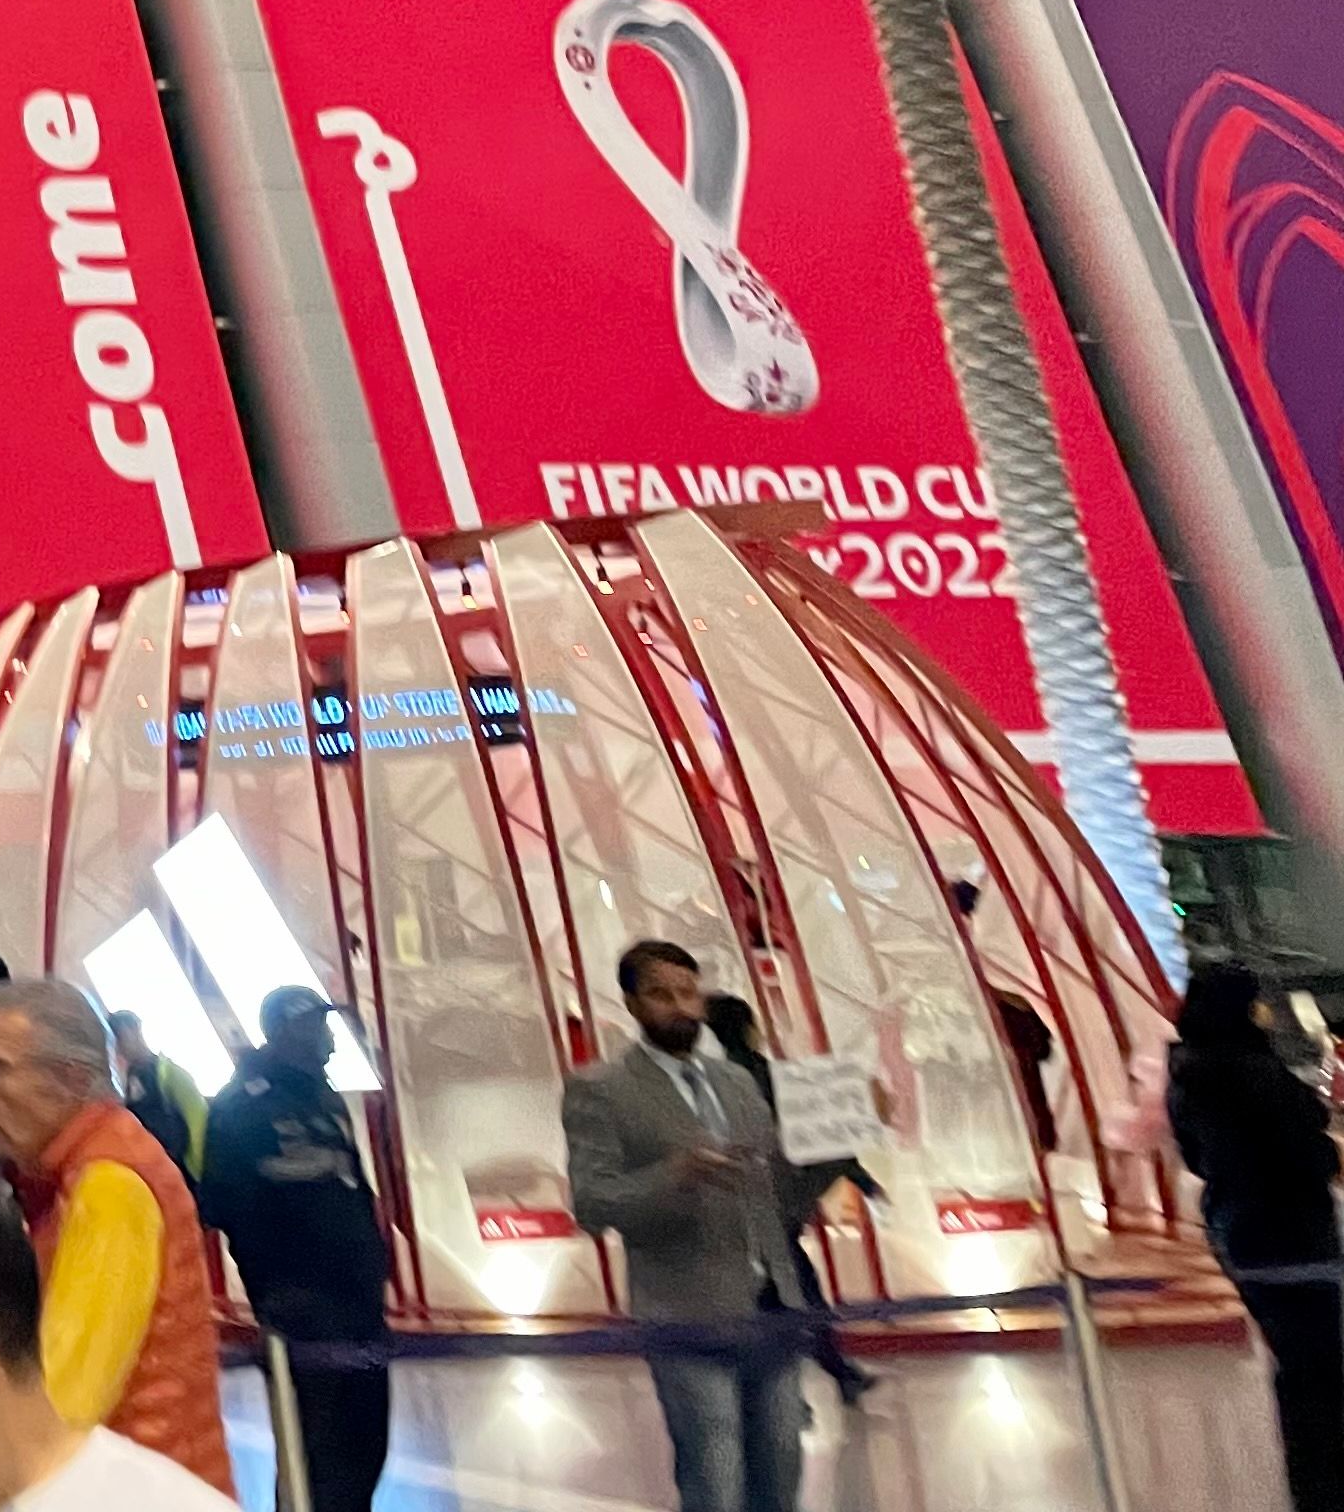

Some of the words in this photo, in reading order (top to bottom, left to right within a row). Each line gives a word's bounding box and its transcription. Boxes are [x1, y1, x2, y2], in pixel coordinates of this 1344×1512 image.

[539, 462, 679, 520] FIFA
[676, 464, 911, 521] WORLD
[914, 464, 1001, 521] CU
